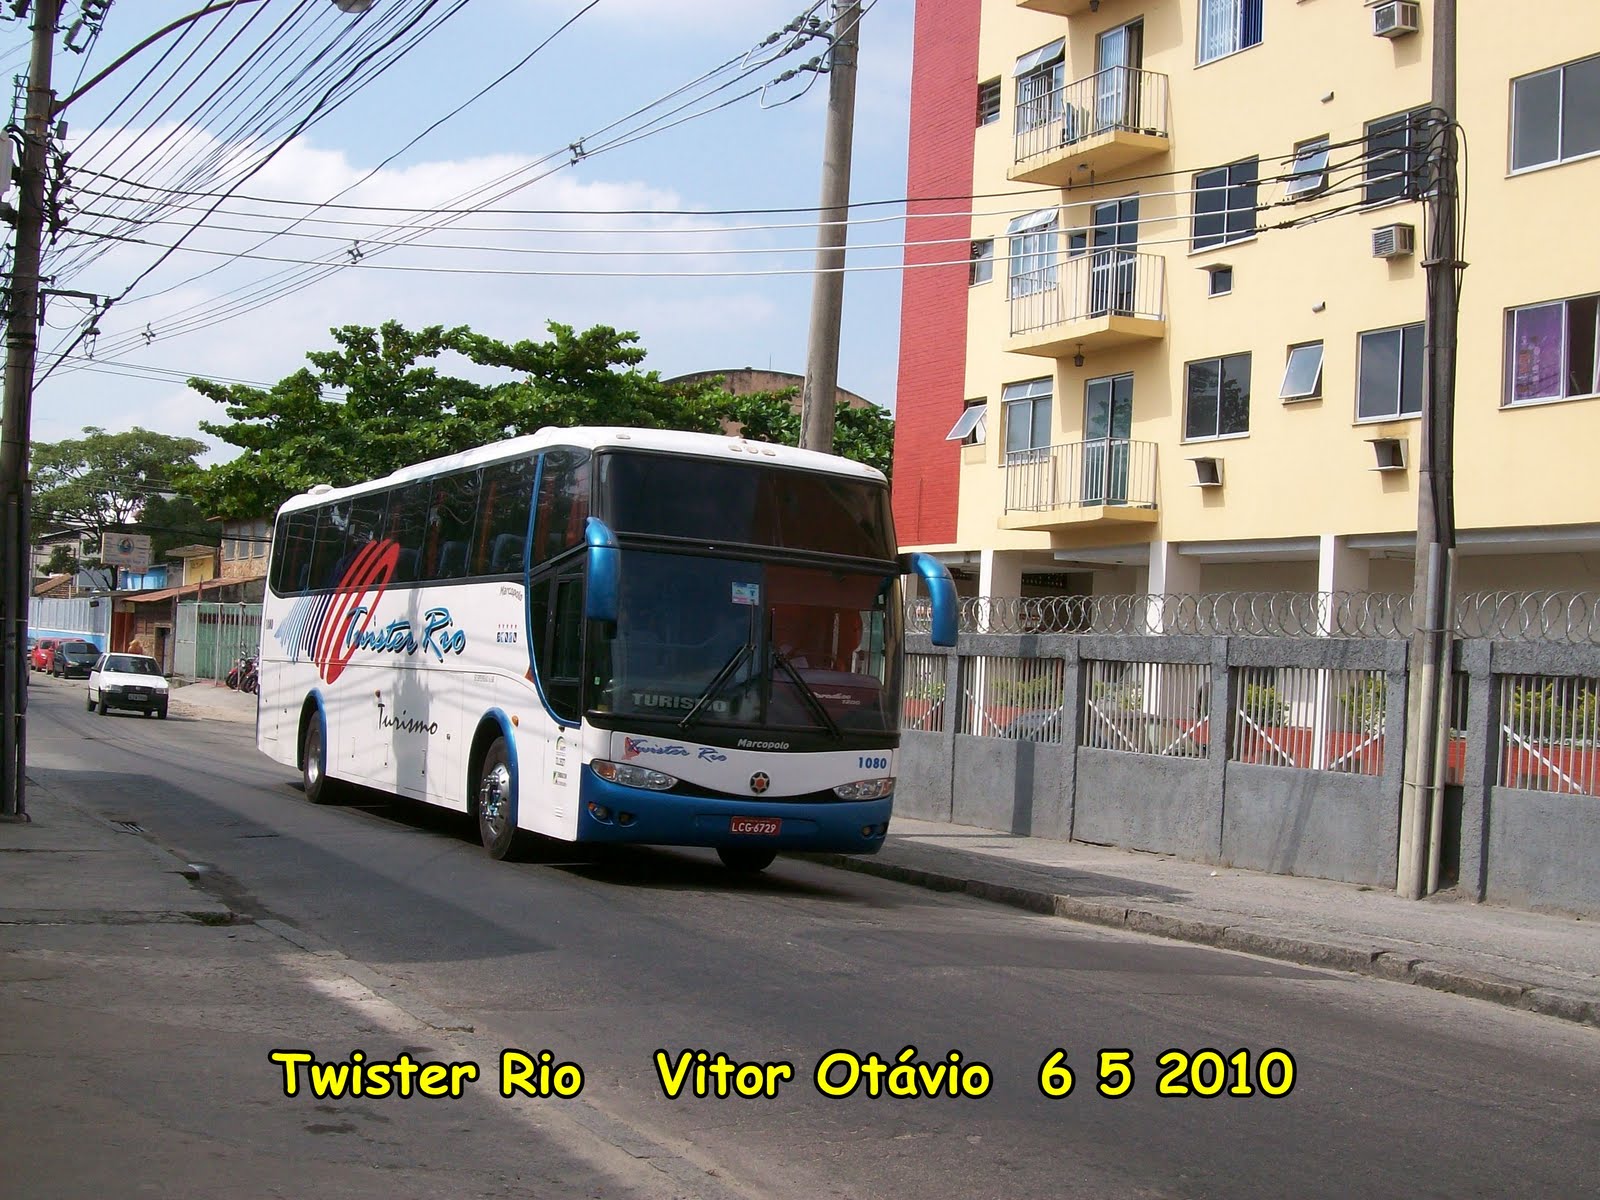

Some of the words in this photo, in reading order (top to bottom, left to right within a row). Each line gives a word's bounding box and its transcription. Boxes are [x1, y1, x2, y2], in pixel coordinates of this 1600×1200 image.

[345, 606, 418, 656] Twister
[422, 607, 466, 663] Rio
[377, 703, 438, 735] Turismo
[627, 738, 690, 757] Twister
[698, 746, 727, 763] Rio
[737, 738, 790, 750] Marcopolo
[858, 756, 887, 770] 1080
[731, 822, 777, 834] LCG-6729
